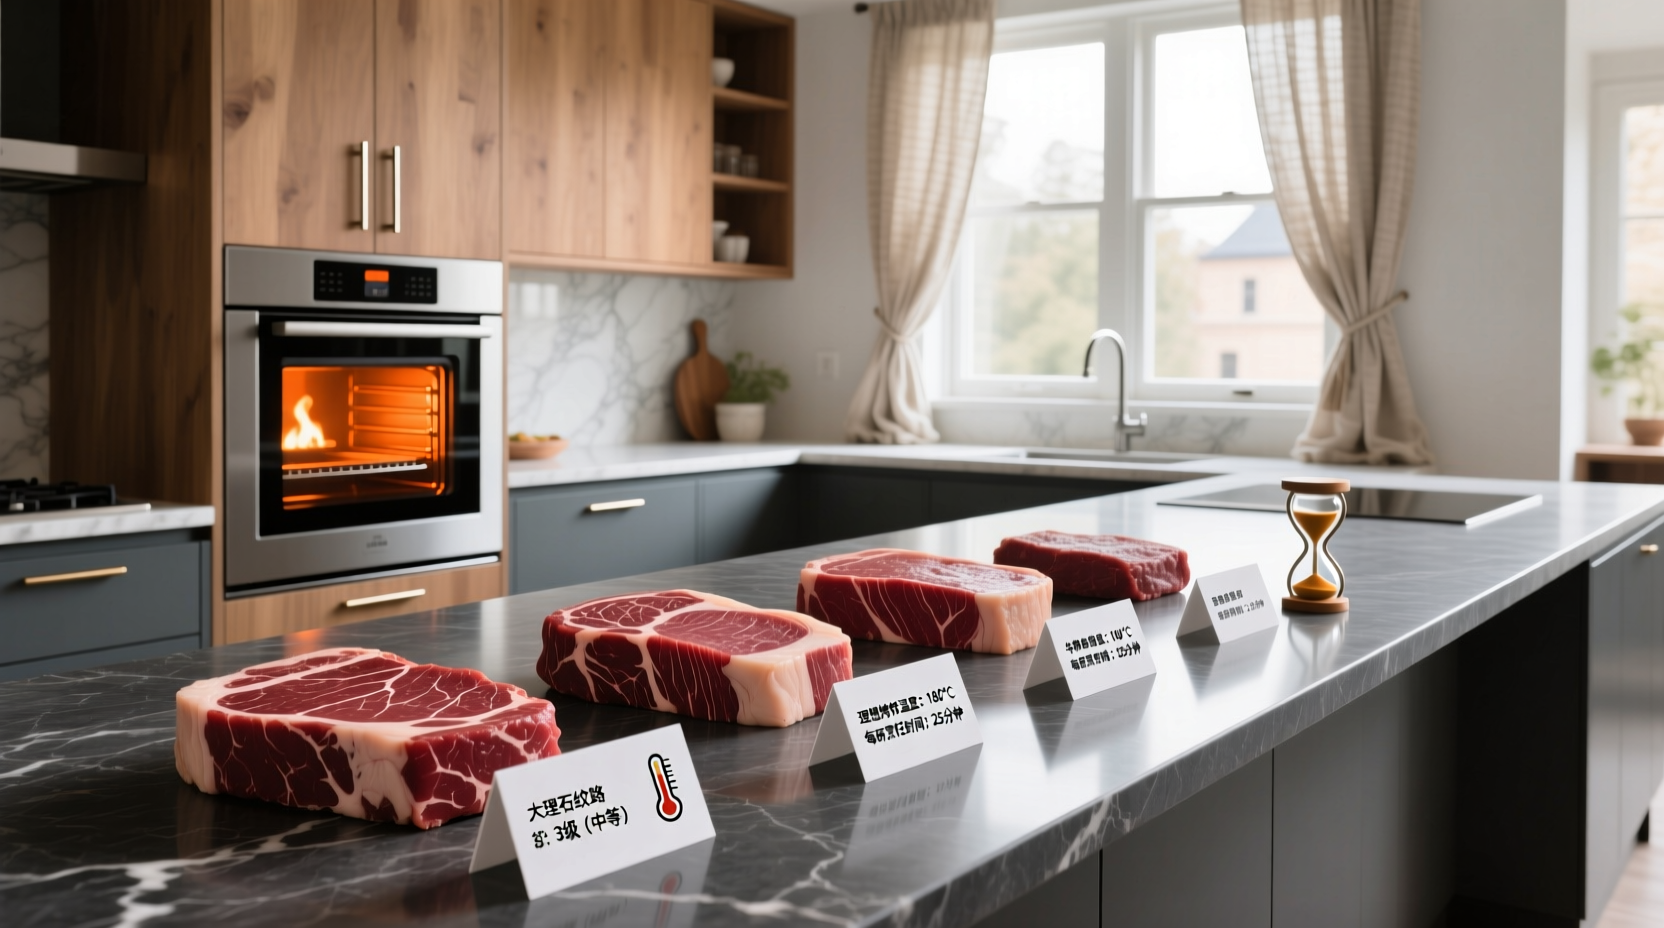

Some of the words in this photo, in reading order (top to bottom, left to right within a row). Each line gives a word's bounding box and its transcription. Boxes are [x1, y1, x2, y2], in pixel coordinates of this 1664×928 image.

[527, 785, 605, 822] 大理石纹路
